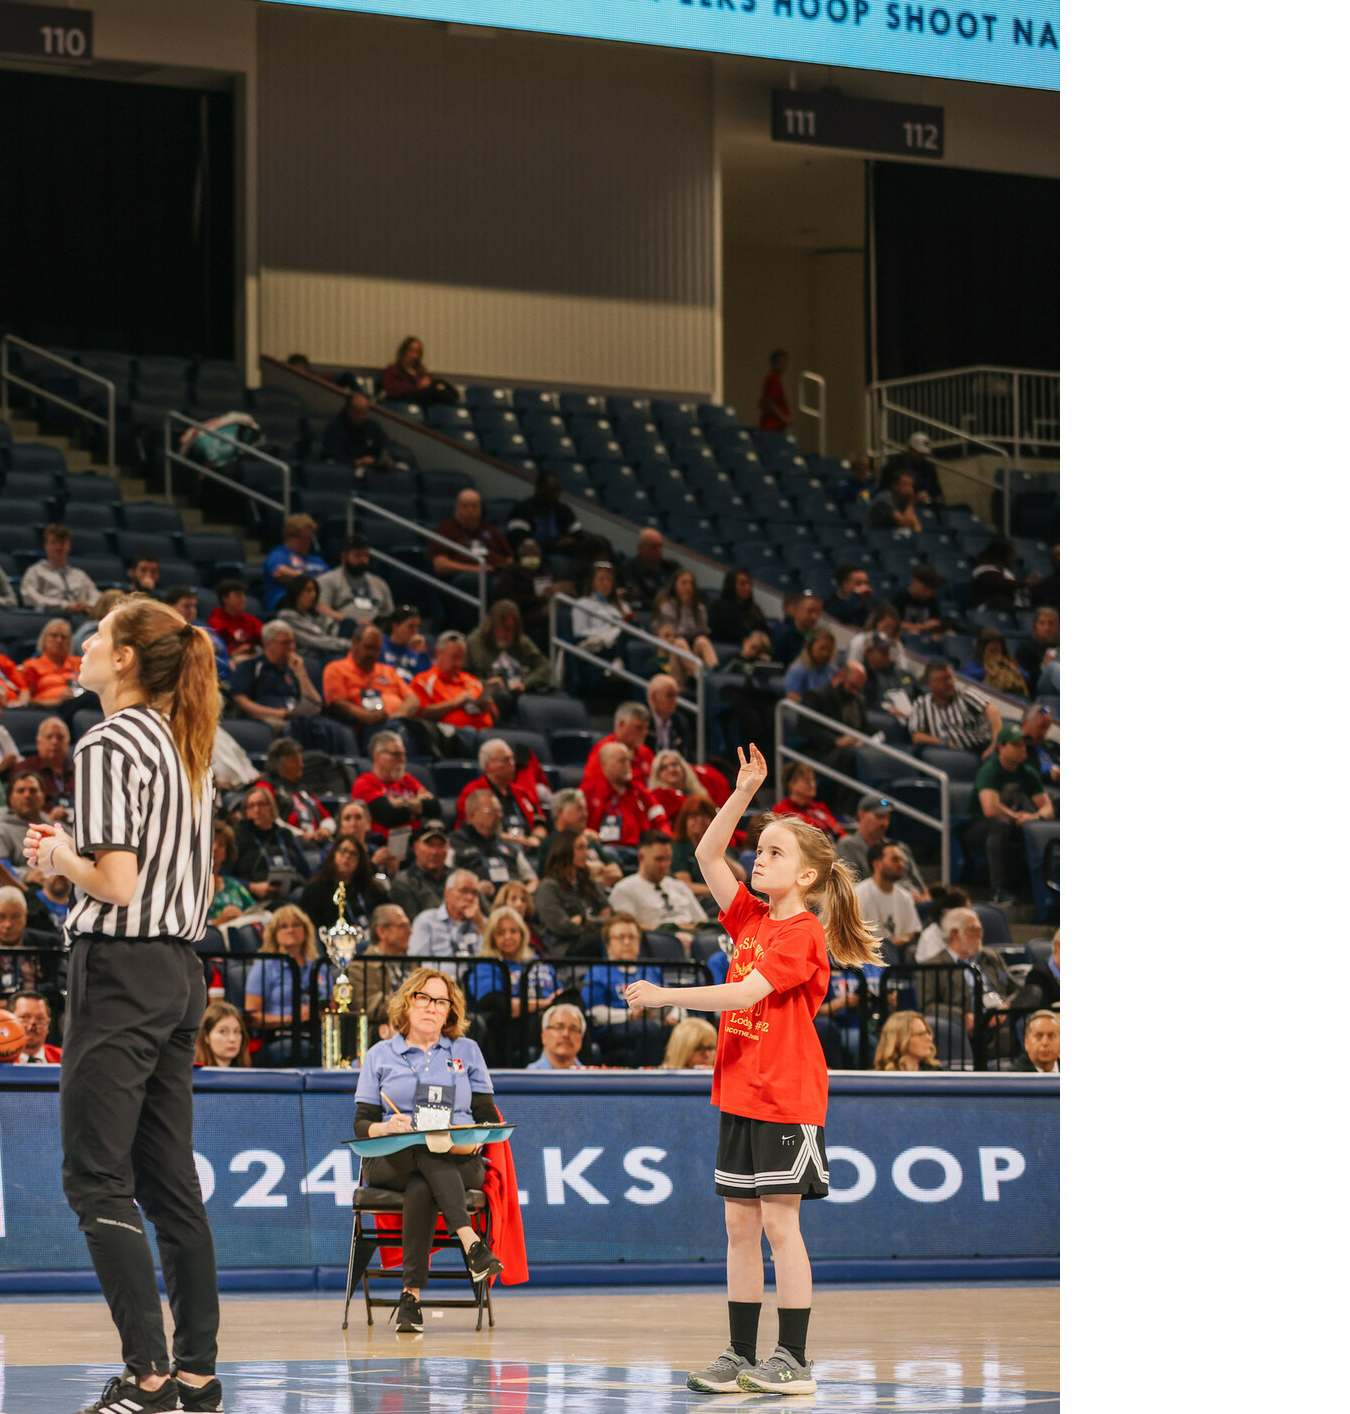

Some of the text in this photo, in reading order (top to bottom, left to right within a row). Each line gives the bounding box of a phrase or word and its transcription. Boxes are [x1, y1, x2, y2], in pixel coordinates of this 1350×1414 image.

[40, 26, 86, 56] 110
[773, 0, 1060, 50] HOOP SHOOT NA
[783, 109, 938, 150] 111 112
[193, 1145, 1026, 1207] 24 KS OOP
